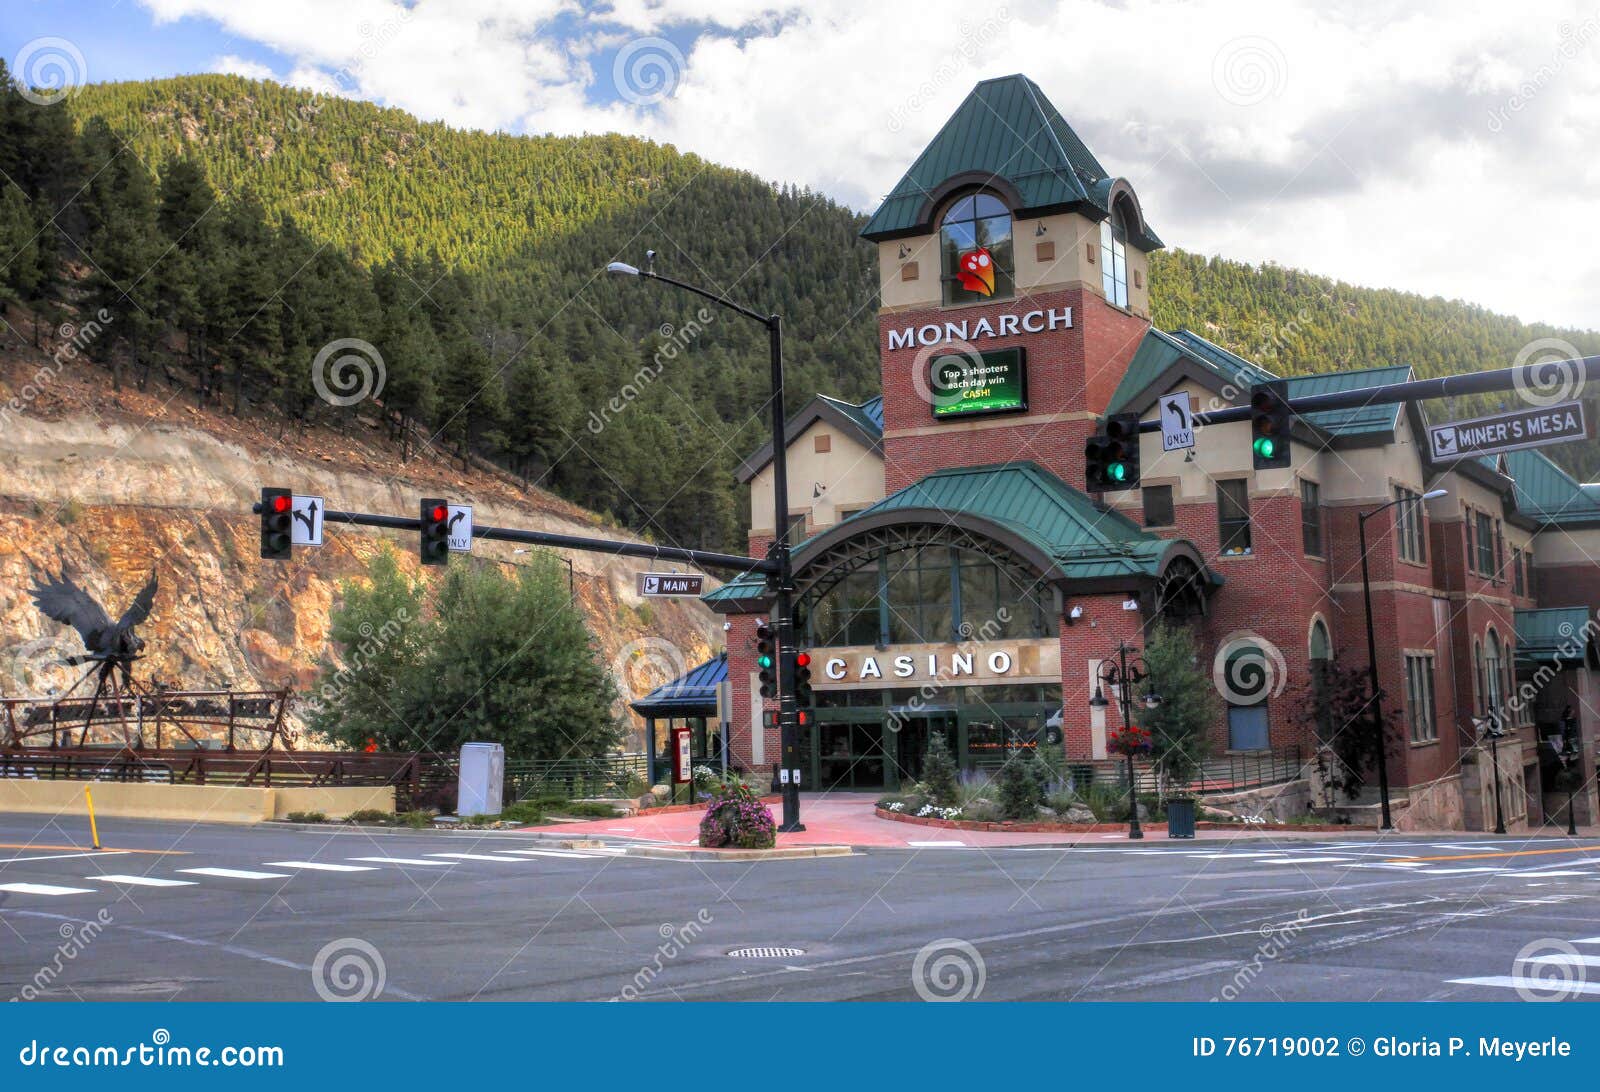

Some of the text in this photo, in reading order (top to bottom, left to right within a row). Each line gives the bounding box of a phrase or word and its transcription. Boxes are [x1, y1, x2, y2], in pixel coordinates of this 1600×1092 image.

[888, 306, 1073, 350] MONARCH
[944, 364, 1009, 379] Top 3 shooters
[948, 375, 1005, 389] each day win
[962, 388, 991, 399] CASH!
[1458, 412, 1578, 448] MINER'S MESA
[1167, 432, 1190, 446] ONLY
[662, 580, 689, 592] MAIN
[825, 651, 1012, 681] CASINO
